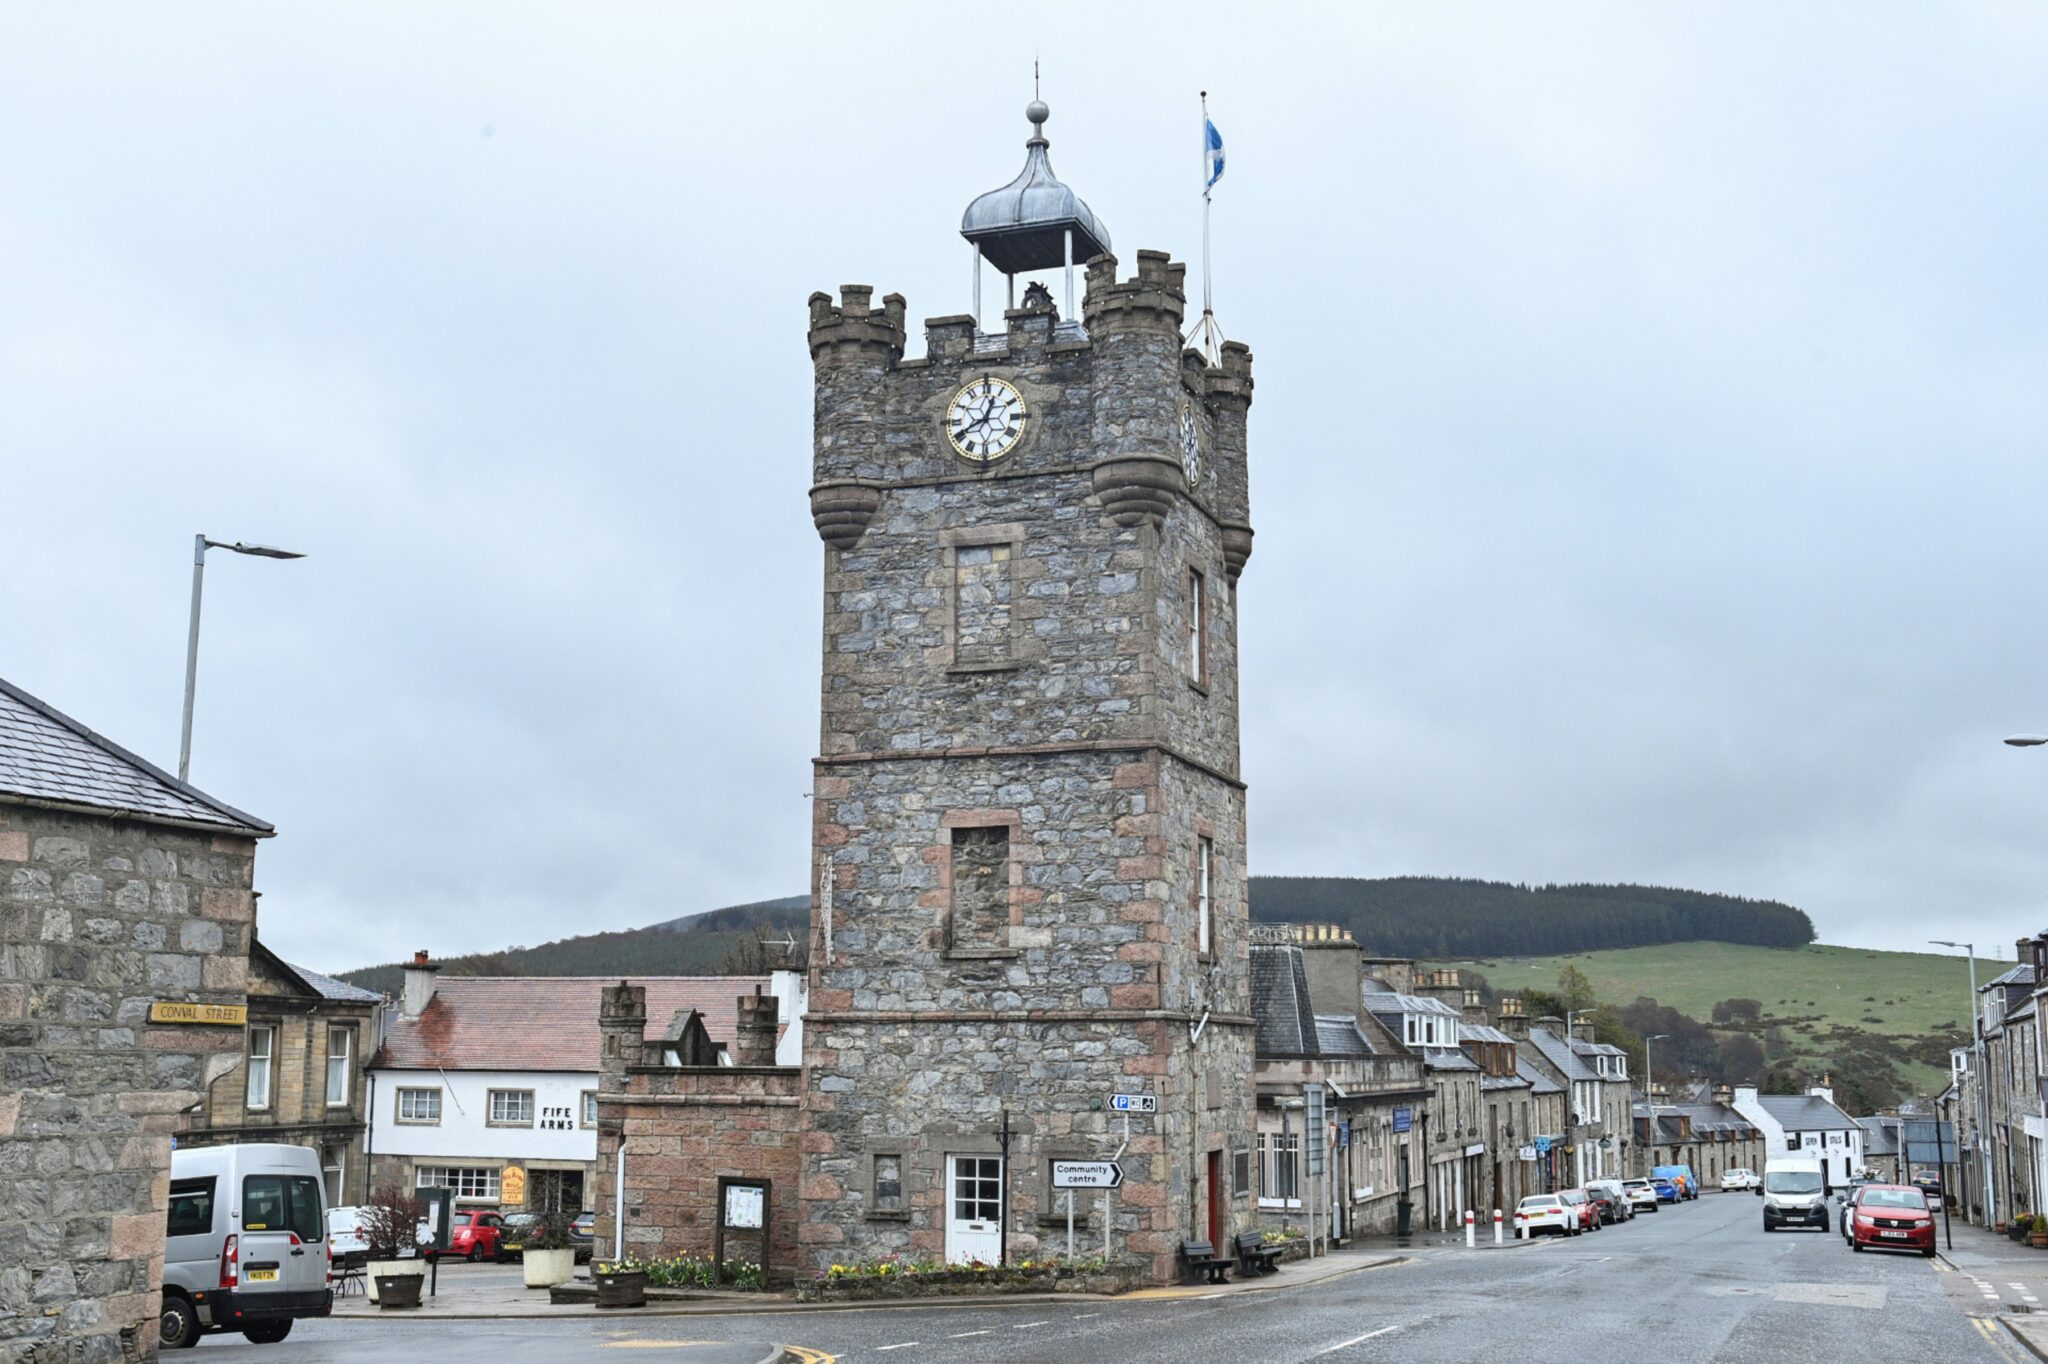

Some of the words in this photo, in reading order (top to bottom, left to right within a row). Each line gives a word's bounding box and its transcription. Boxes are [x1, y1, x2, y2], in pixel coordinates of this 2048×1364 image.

[160, 1006, 197, 1020] CONVAL
[205, 1008, 240, 1021] STREET
[543, 1107, 571, 1118] FIFE
[540, 1119, 574, 1130] ARMS
[1057, 1164, 1108, 1175] Community
[1067, 1175, 1097, 1183] centre
